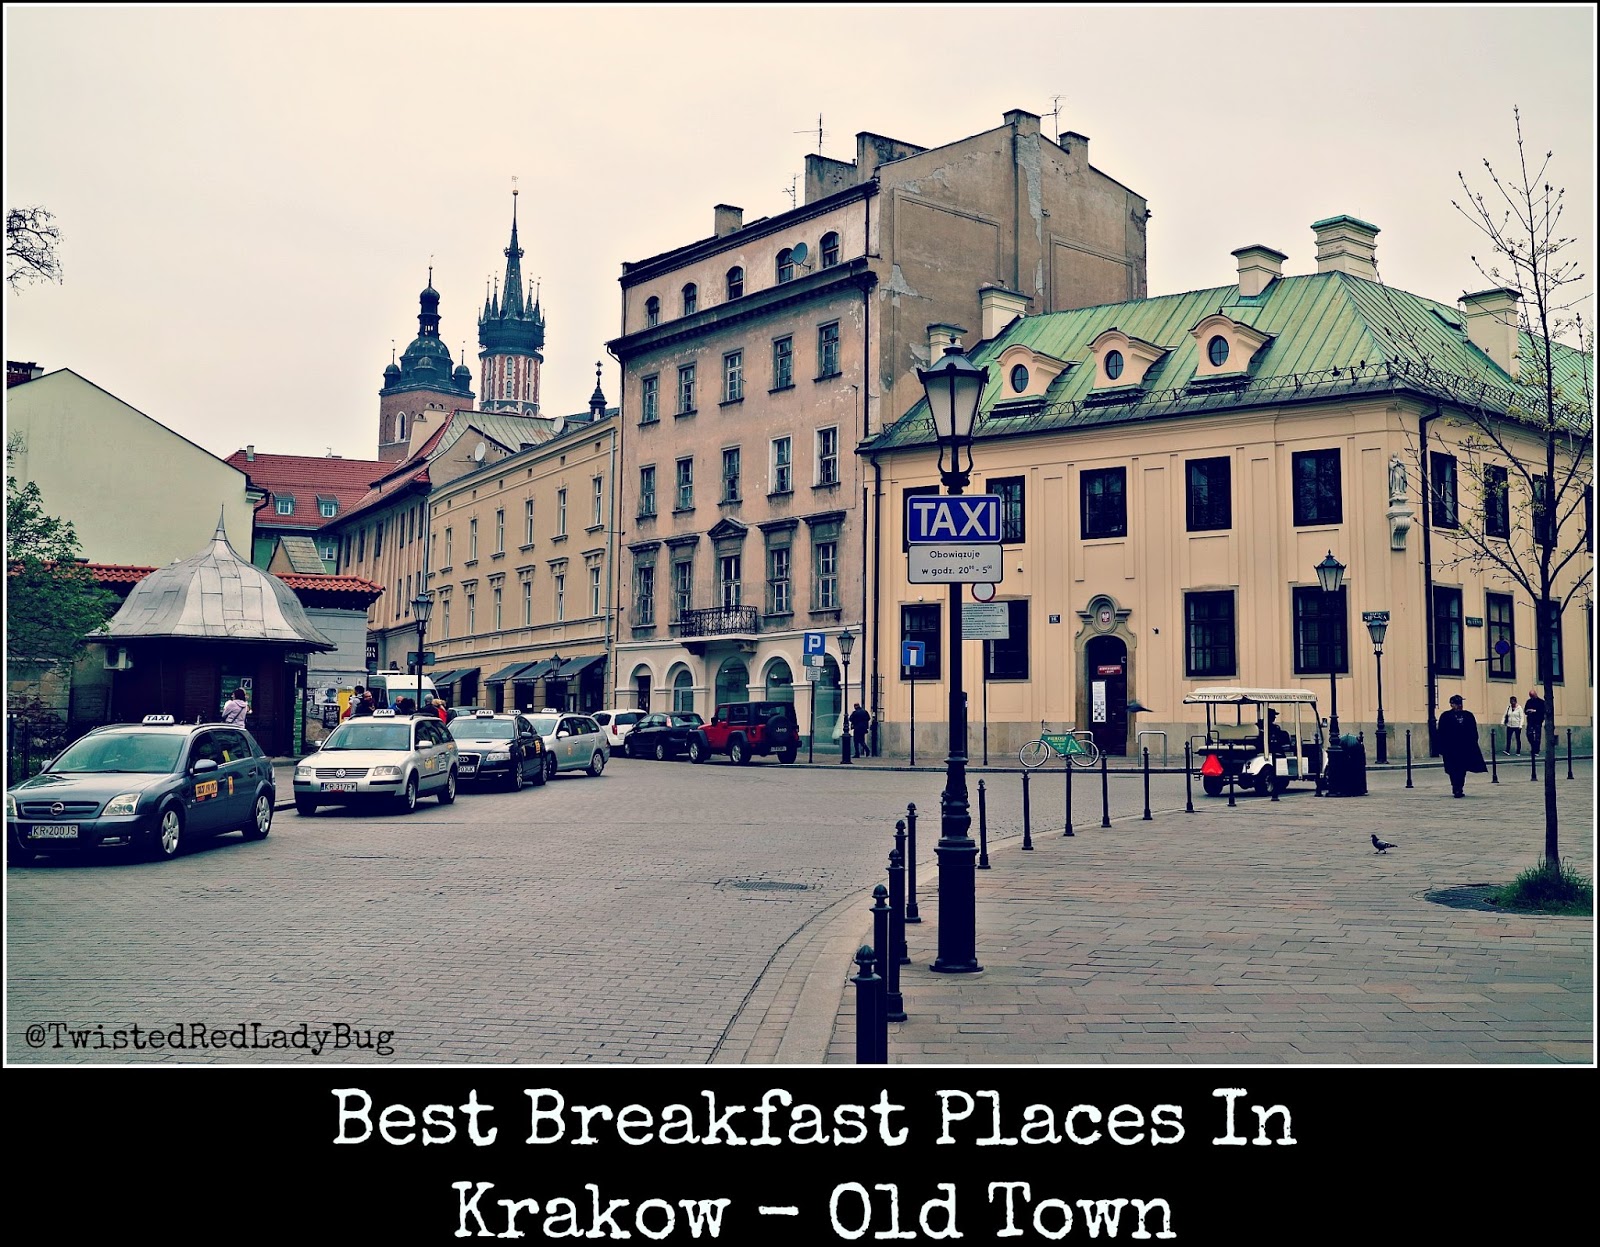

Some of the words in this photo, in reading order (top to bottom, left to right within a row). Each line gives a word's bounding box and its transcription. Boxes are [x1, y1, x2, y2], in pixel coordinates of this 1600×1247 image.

[912, 501, 996, 537] TAXI
[929, 550, 980, 560] Obowiązuje
[931, 566, 955, 577] godz.
[808, 635, 821, 653] P
